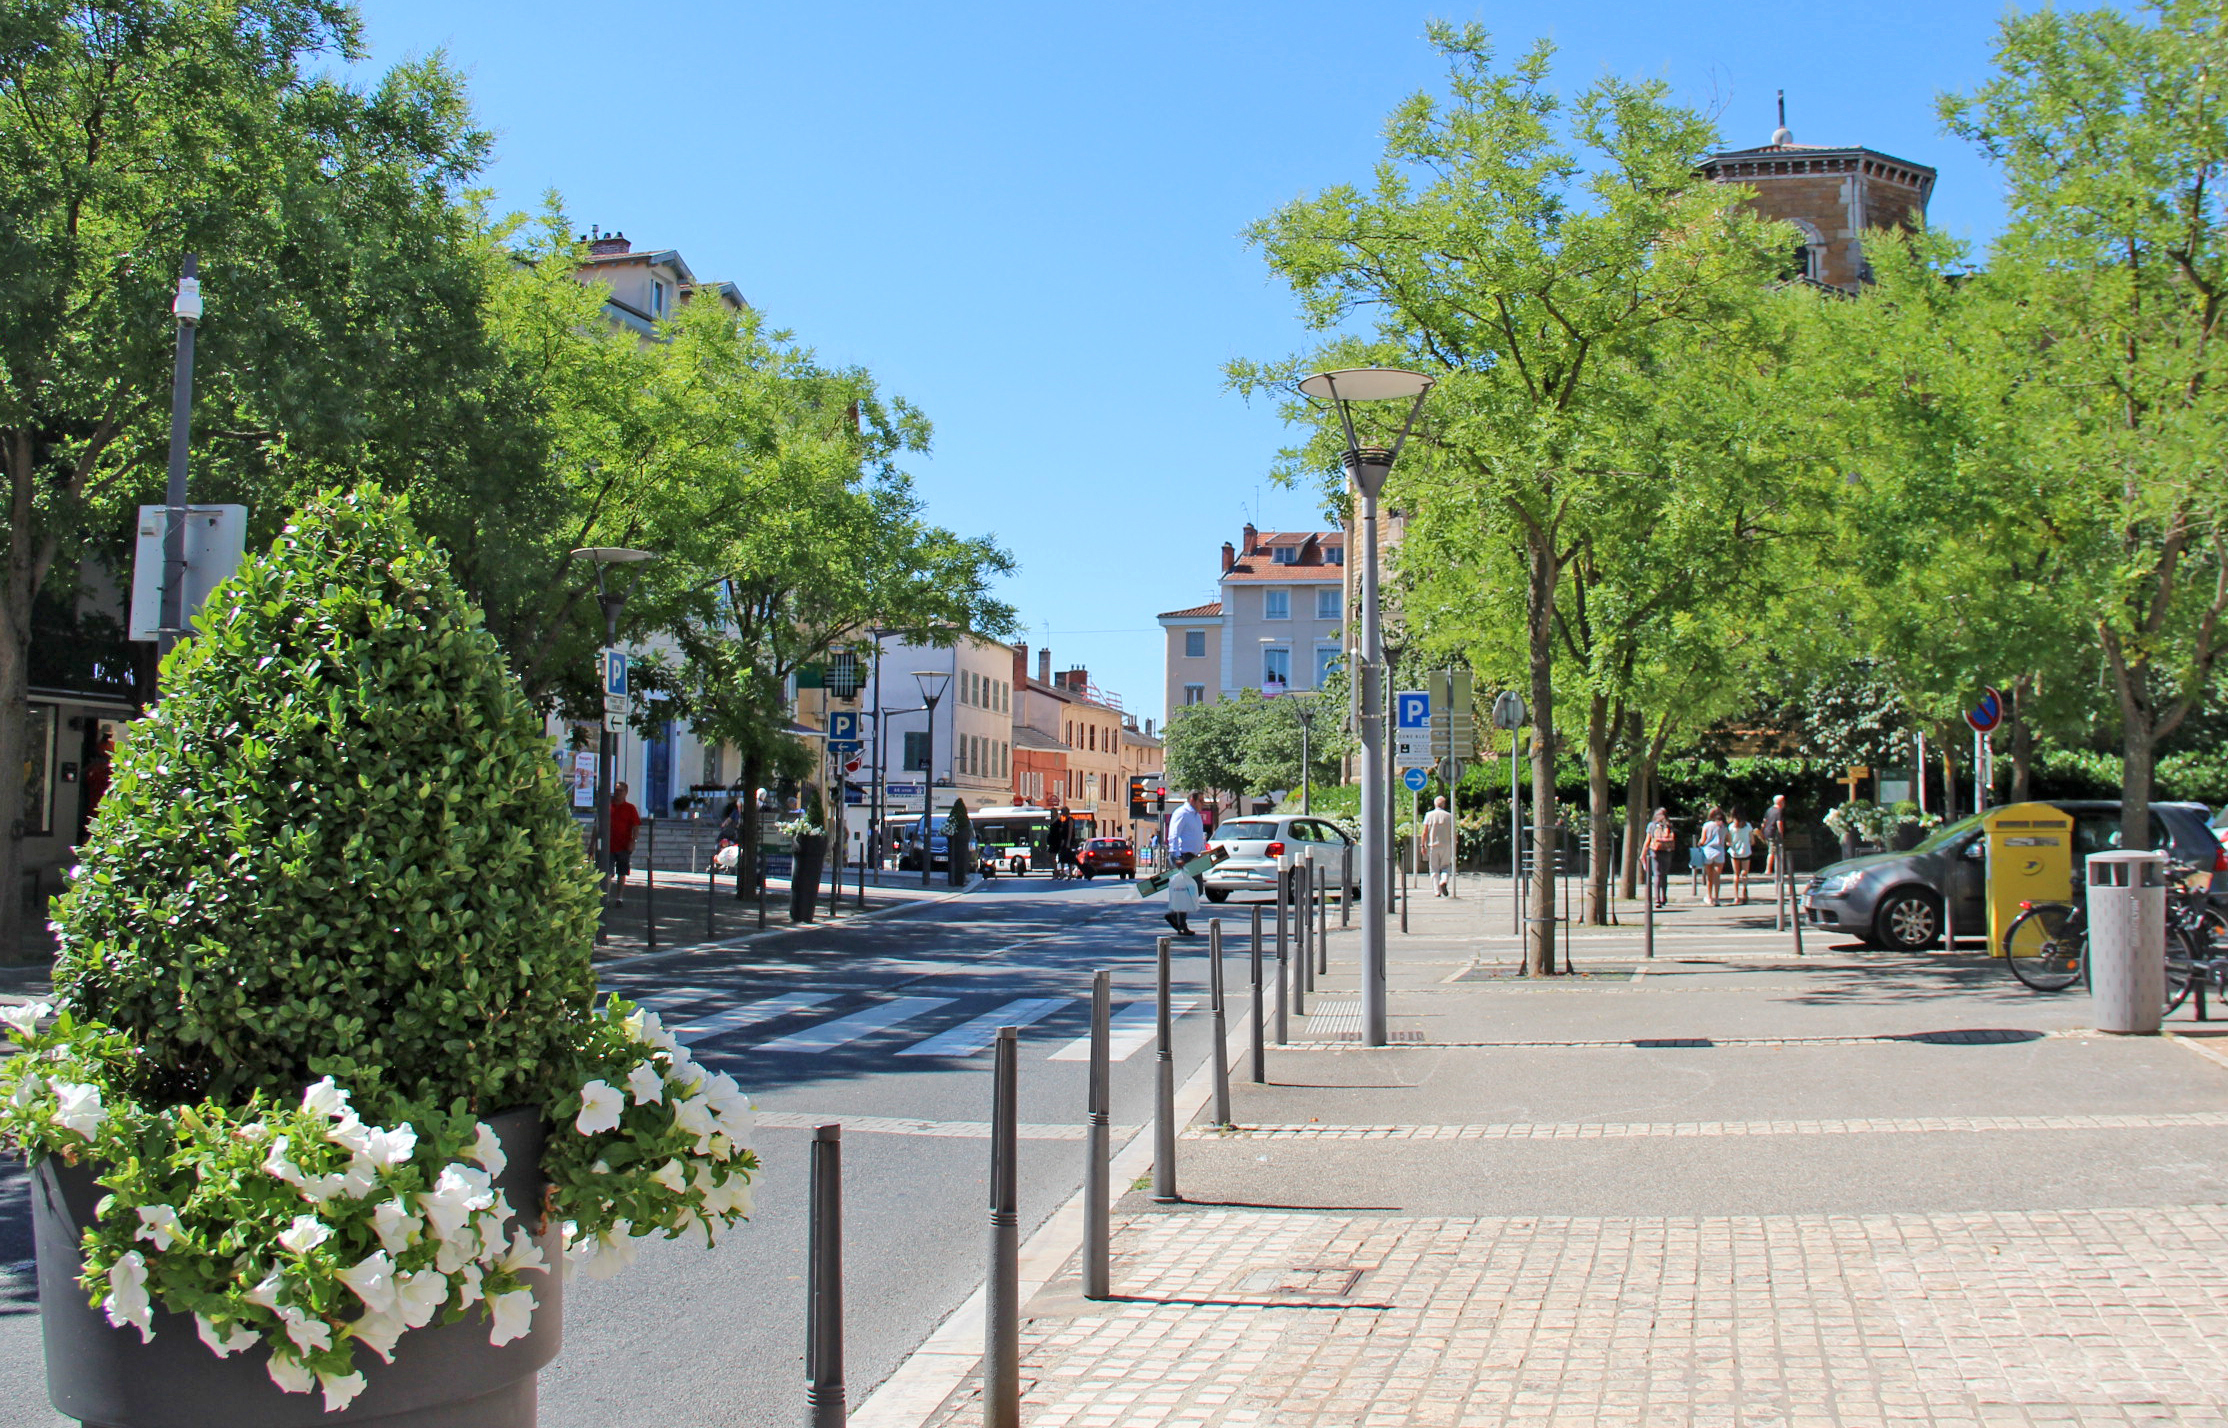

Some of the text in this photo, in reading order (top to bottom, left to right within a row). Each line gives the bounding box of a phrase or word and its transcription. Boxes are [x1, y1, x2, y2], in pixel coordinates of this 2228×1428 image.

[613, 660, 621, 686] P
[1407, 700, 1423, 722] P
[836, 716, 850, 735] P
